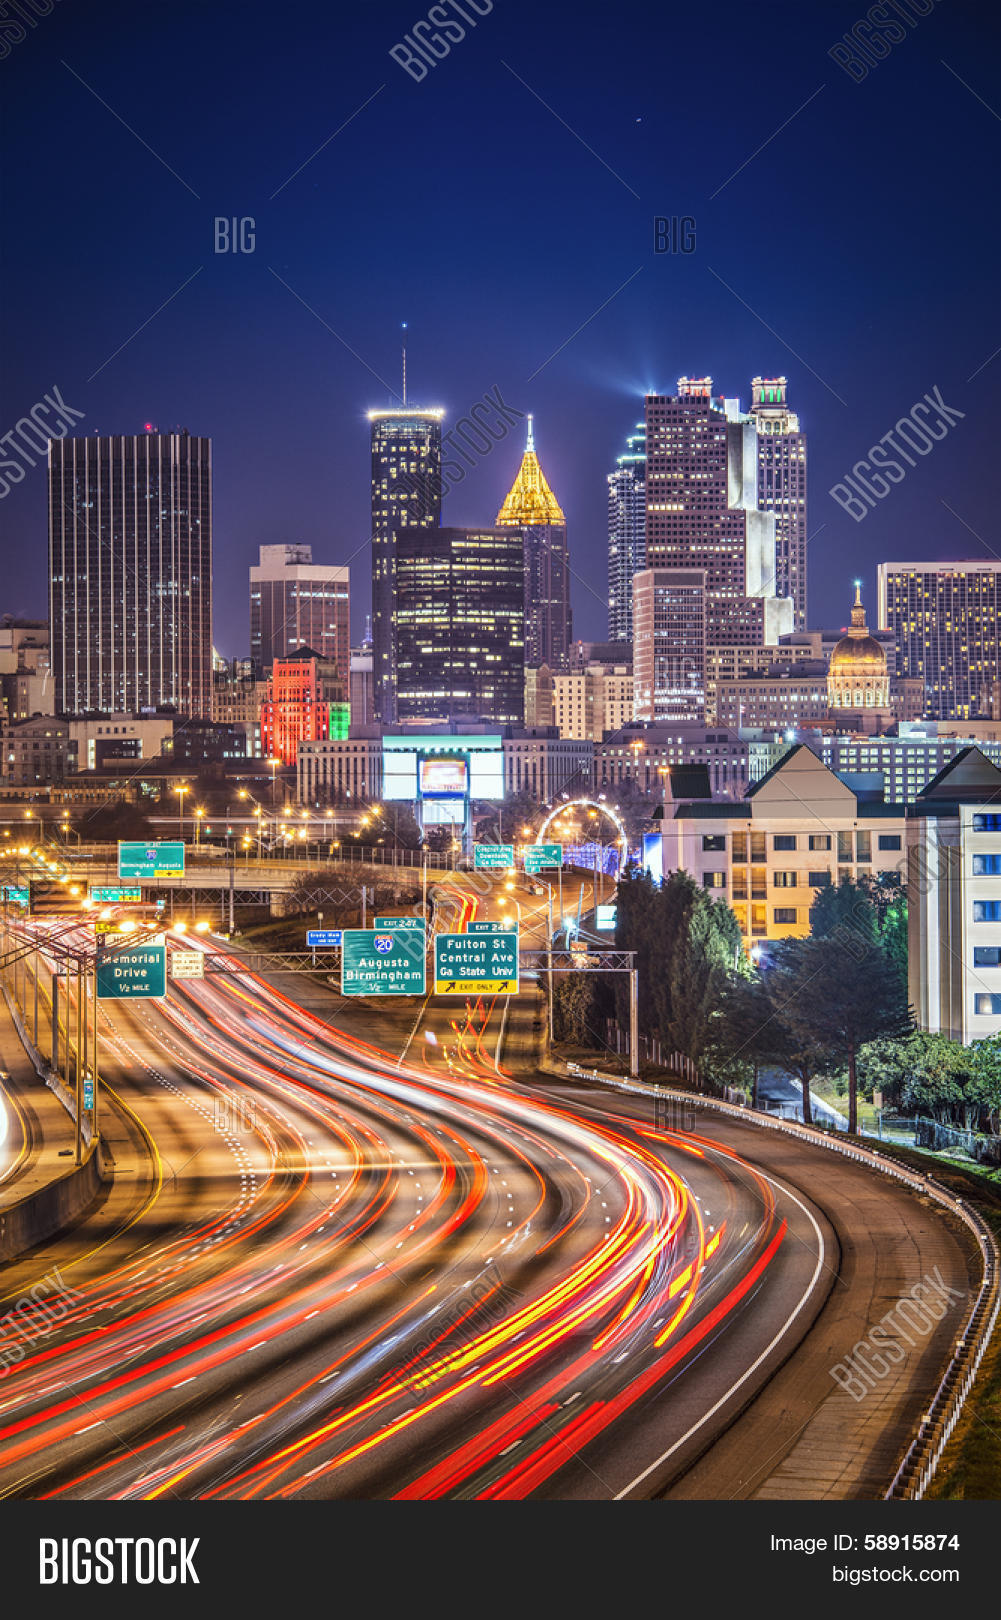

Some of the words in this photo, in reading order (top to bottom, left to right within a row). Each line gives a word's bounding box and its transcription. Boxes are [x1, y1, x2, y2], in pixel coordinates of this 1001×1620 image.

[399, 920, 416, 928] 247
[491, 923, 511, 931] 24
[377, 940, 393, 951] 20
[447, 939, 487, 949] Fulton
[493, 939, 507, 949] St
[102, 953, 160, 964] Memorial
[440, 953, 485, 963] Central
[491, 953, 514, 963] Ave
[358, 958, 409, 969] Augusta
[114, 968, 148, 977] Drive
[346, 970, 421, 982] Birmingham
[440, 967, 454, 976] Ga
[459, 967, 486, 976] State
[492, 967, 514, 976] Univ
